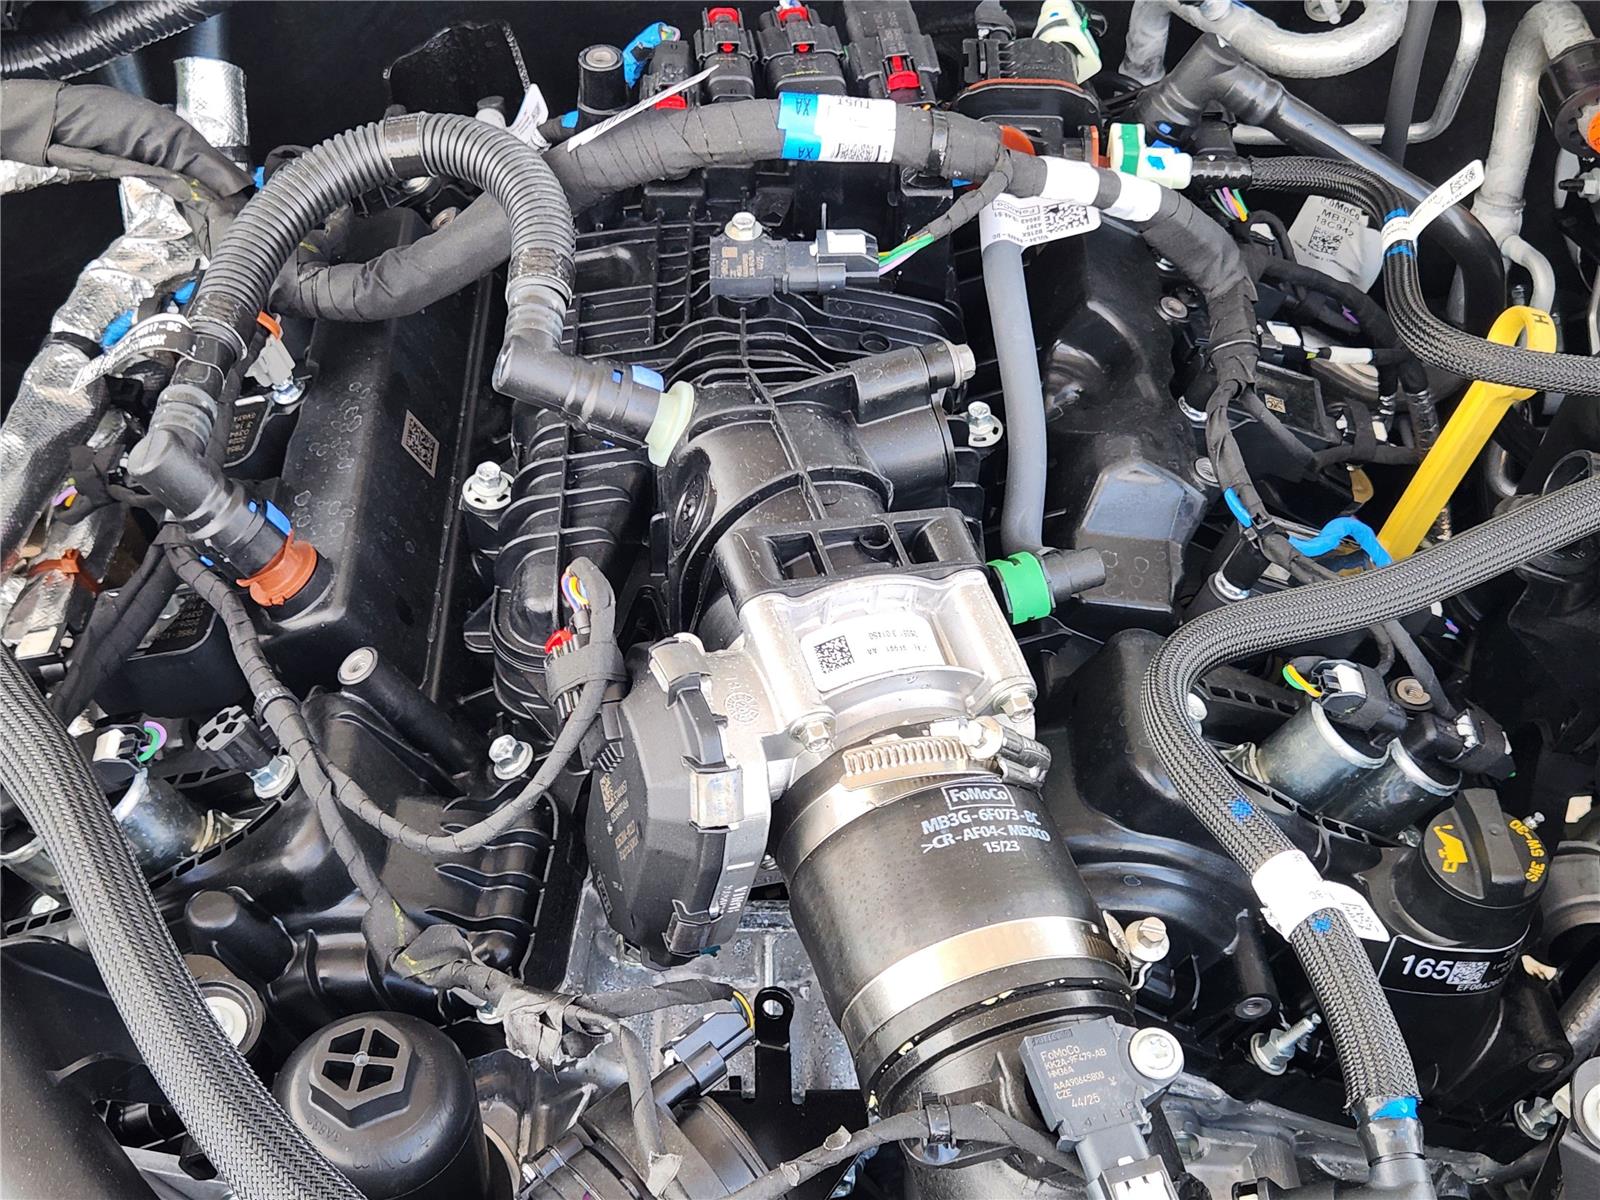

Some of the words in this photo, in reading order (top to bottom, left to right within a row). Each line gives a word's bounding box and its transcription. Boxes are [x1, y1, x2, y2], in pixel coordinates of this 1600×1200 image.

[796, 98, 811, 116] XA
[1321, 209, 1354, 227] MB3T
[949, 787, 1009, 802] FoMoCo
[921, 807, 1042, 835] MB3G-6F073-BC
[1007, 824, 1051, 843] MEXICO
[1508, 819, 1545, 858] 5W-30
[983, 840, 1020, 853] 15/23
[1525, 861, 1546, 883] SAE
[1402, 954, 1454, 980] 165
[1041, 1045, 1080, 1061] FoMoCo
[1056, 1088, 1073, 1099] CZE
